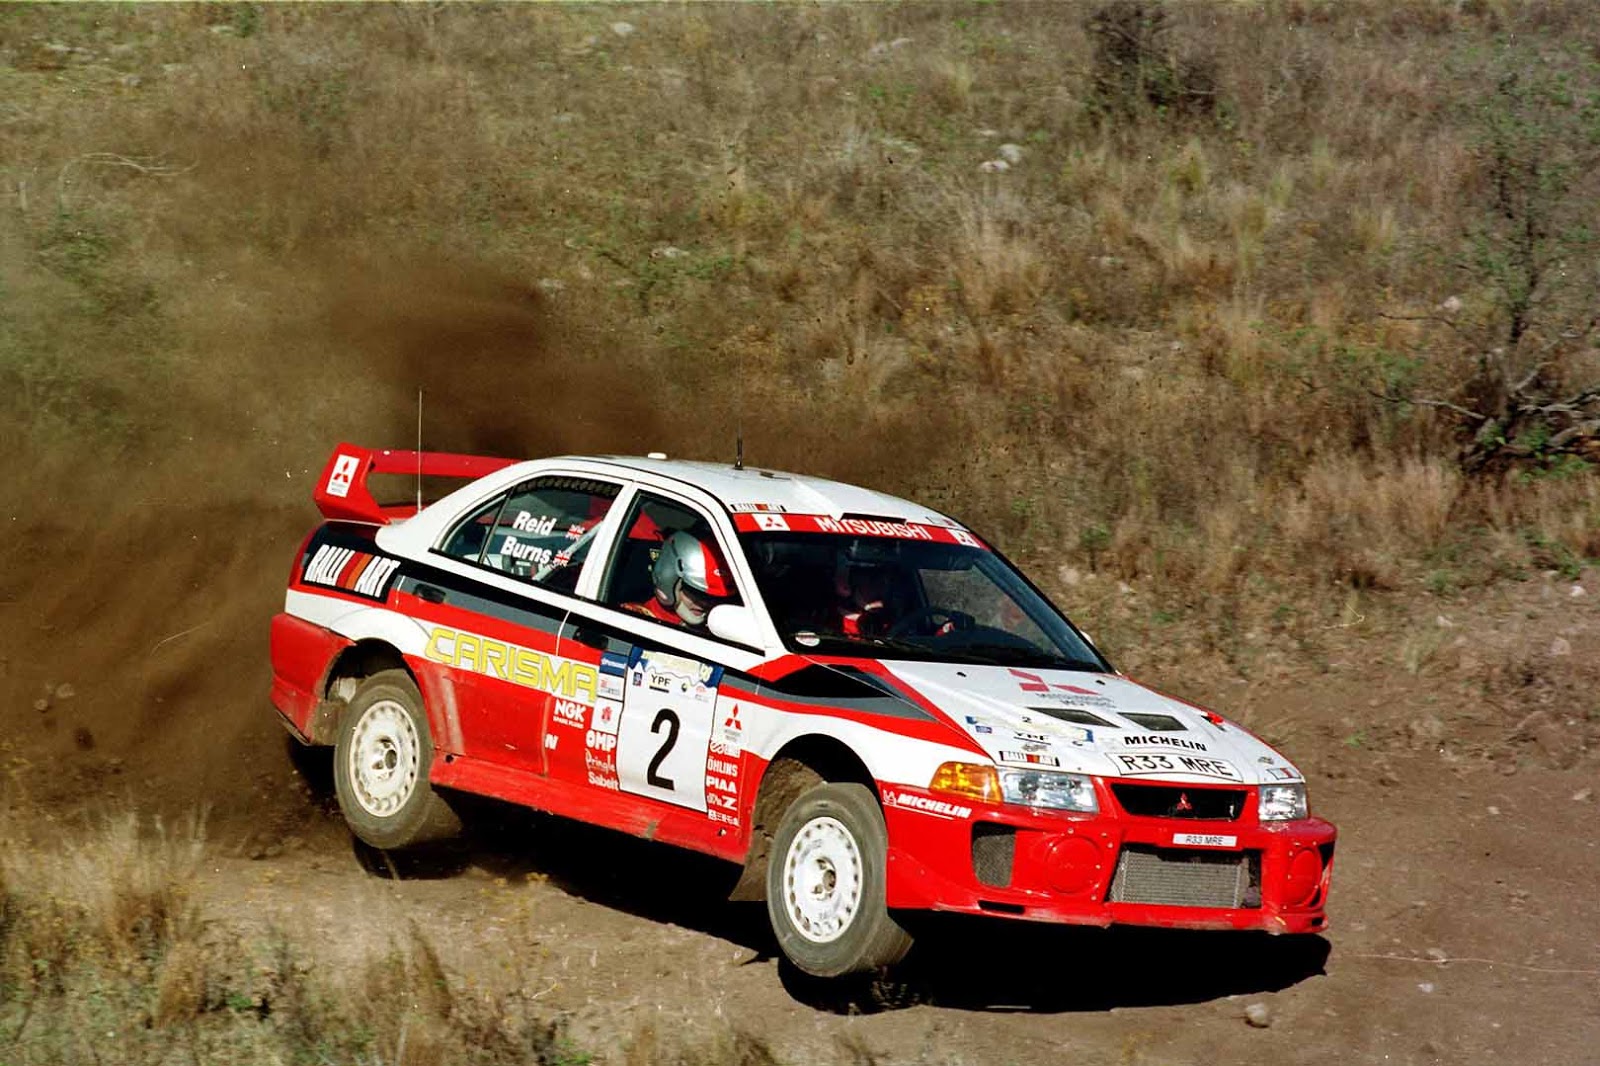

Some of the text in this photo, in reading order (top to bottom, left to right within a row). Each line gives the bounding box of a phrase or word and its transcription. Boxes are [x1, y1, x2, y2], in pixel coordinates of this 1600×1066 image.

[512, 511, 557, 536] Reid
[813, 516, 933, 540] MITSUBISHI
[500, 535, 552, 565] Burns
[425, 627, 598, 703] CARISMA
[650, 674, 671, 687] YPF
[554, 699, 586, 722] NGK
[586, 730, 617, 752] OMP
[646, 708, 681, 791] 2
[1123, 735, 1207, 752] MICHELIN
[1117, 755, 1233, 776] R33 MRE
[706, 775, 737, 794] PIAA
[897, 793, 973, 819] MICHELIN
[1185, 835, 1225, 846] R33 MRE
